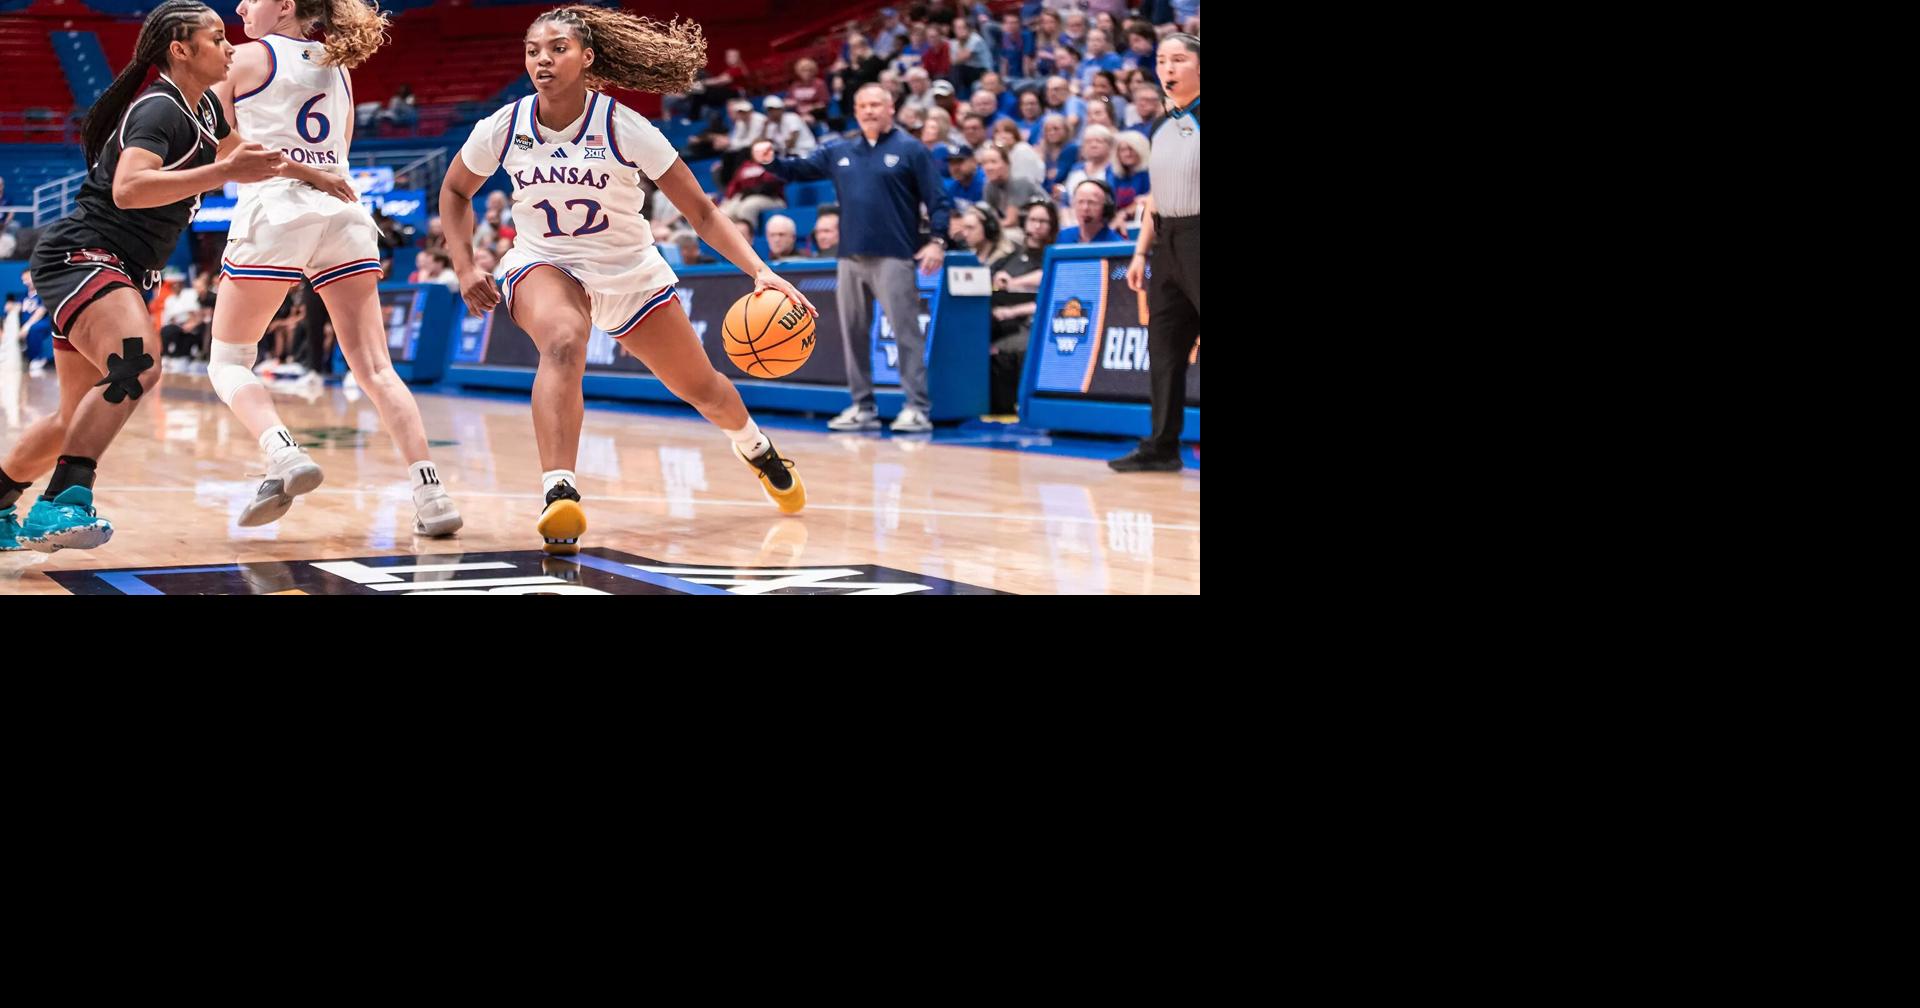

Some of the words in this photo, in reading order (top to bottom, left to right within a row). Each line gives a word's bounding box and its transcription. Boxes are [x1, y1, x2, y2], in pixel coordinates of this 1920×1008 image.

[295, 93, 330, 144] 6
[514, 166, 610, 190] KANSAS
[532, 199, 609, 237] 12
[1102, 327, 1150, 371] ELEV
